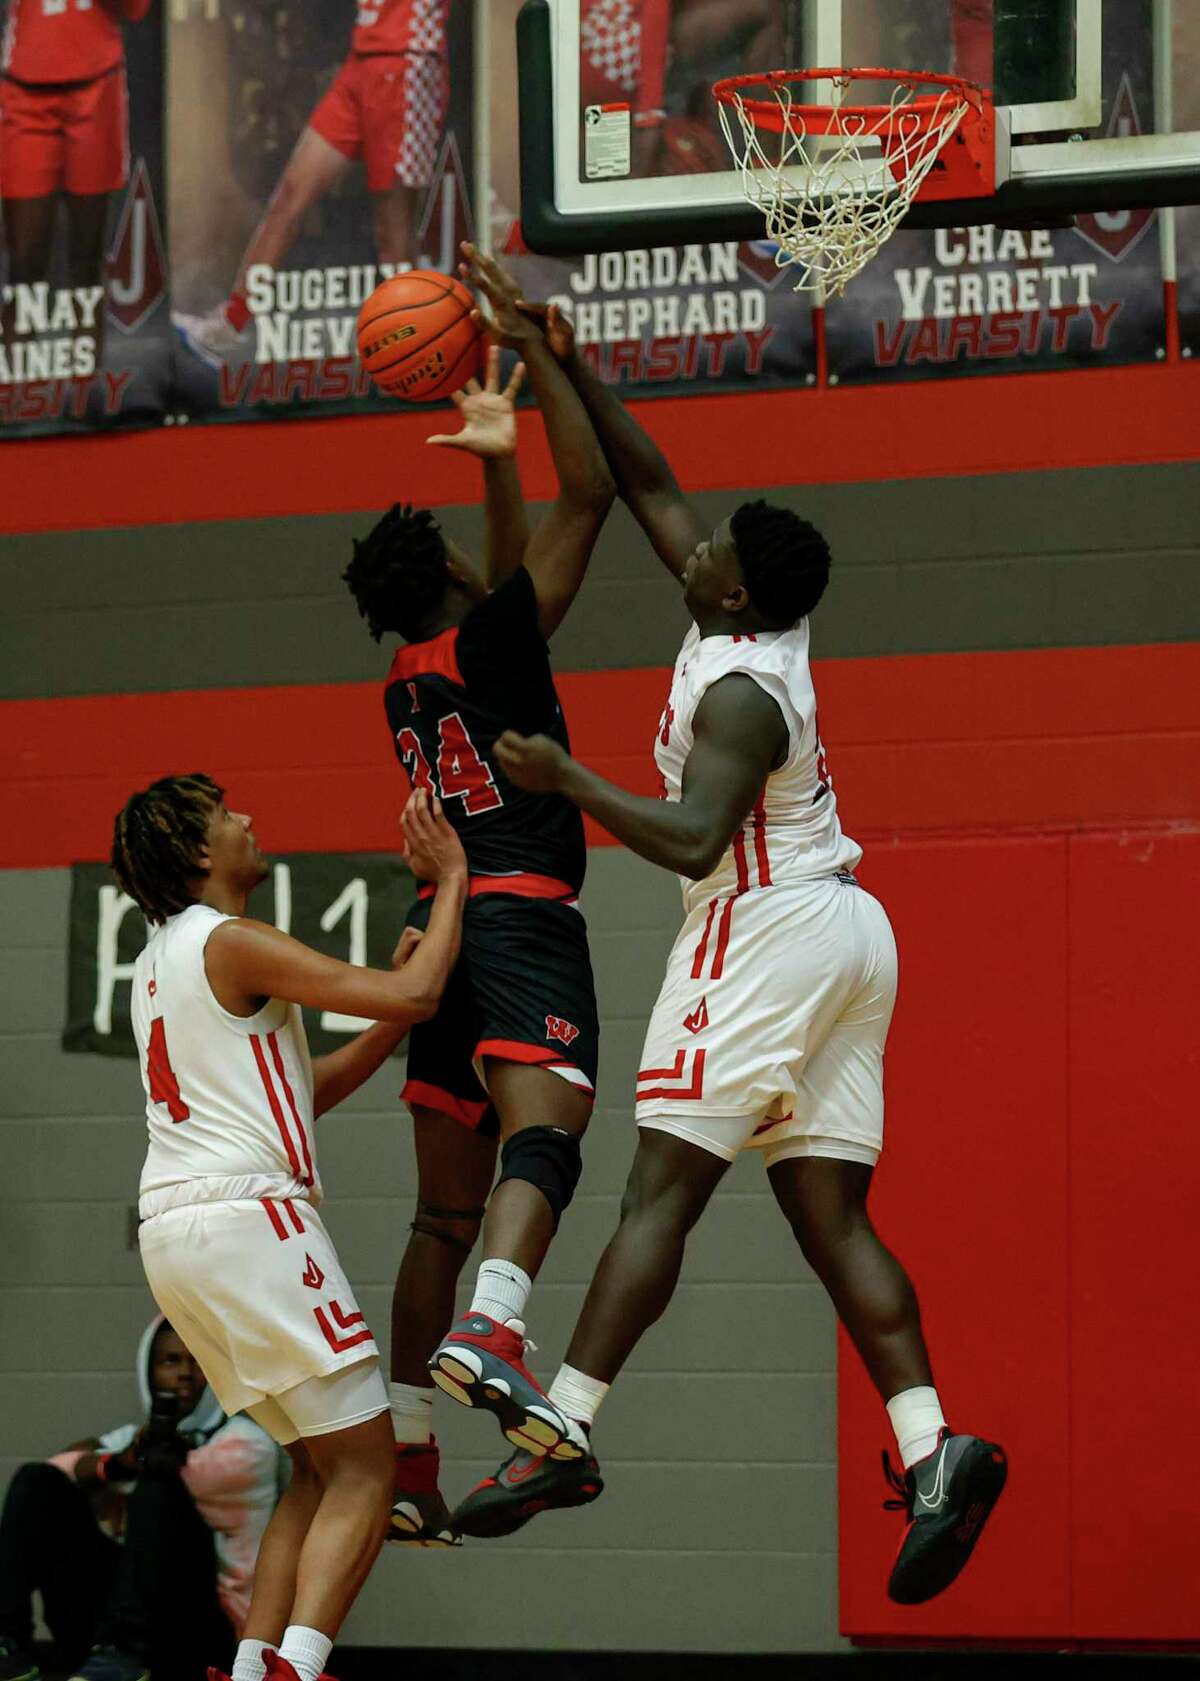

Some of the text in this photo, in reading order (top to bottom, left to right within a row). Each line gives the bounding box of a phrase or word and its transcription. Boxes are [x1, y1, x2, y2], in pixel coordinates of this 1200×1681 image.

[570, 241, 739, 294] JORDAN
[934, 224, 1054, 266] CHAE
[0, 282, 104, 334] 'NAY
[895, 264, 1097, 321] VERRETT
[255, 312, 357, 363] NIEV
[577, 326, 775, 384] ARSITY
[873, 300, 1123, 366] VARSITY
[218, 354, 372, 407] VARSI
[397, 712, 504, 816] 24
[544, 1014, 580, 1046] W
[146, 1015, 190, 1124] 4
